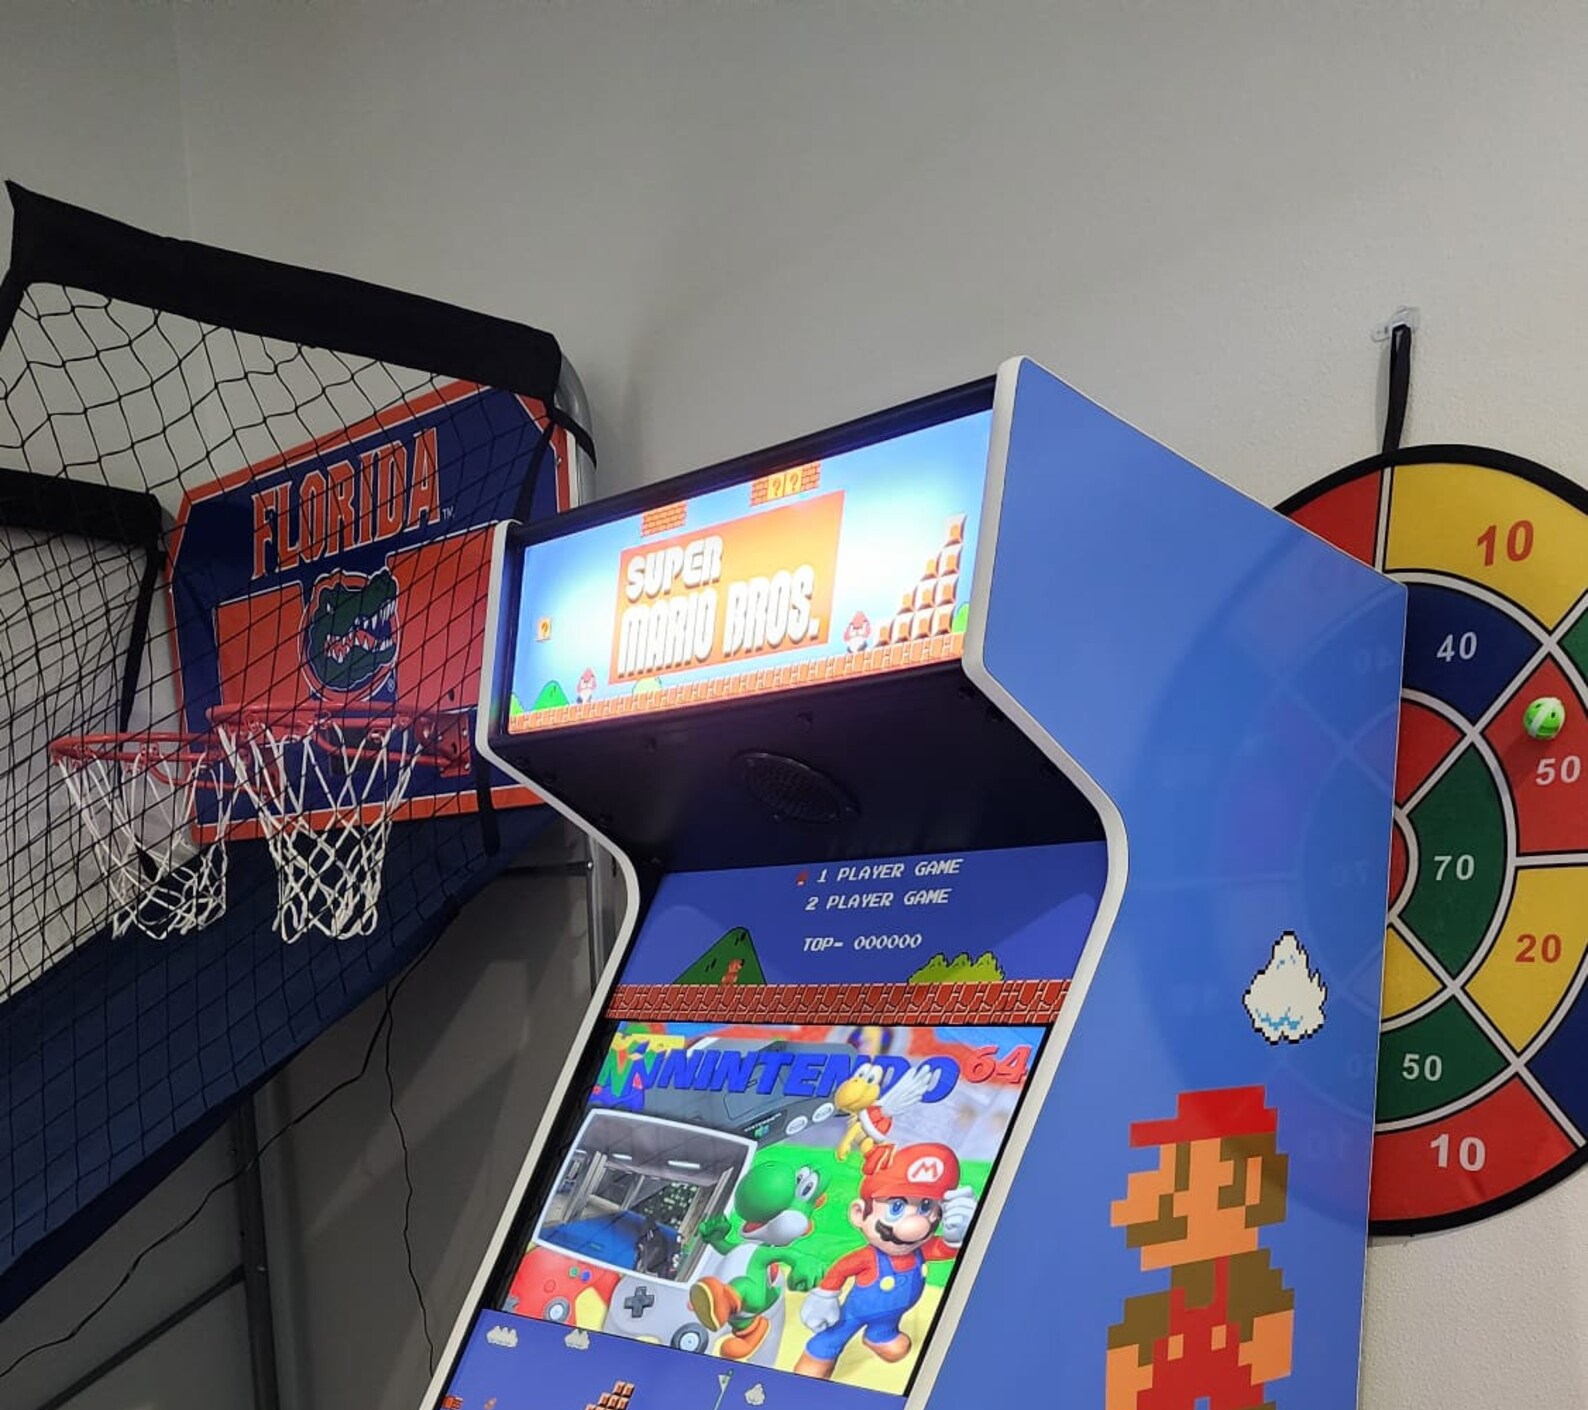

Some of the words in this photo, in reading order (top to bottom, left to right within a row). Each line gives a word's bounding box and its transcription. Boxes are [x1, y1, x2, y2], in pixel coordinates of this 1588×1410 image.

[251, 427, 441, 581] FLORIDA
[1477, 519, 1534, 567] 10
[625, 535, 724, 603] SUPER
[617, 588, 718, 679] MARIO
[723, 564, 820, 658] BROS.
[1436, 631, 1478, 663] 40
[1535, 755, 1581, 786] 50
[817, 869, 827, 883] 1
[837, 863, 904, 882] PLAYER
[914, 858, 964, 877] GAME
[1433, 854, 1475, 881] 70
[805, 896, 819, 911] 2
[826, 892, 894, 910] PLAYER
[903, 888, 952, 906] GAME
[853, 933, 923, 950] 000000
[1515, 934, 1562, 963] 20
[961, 1045, 1031, 1084] 64
[1402, 1053, 1443, 1082] 50
[1429, 1133, 1487, 1172] 10
